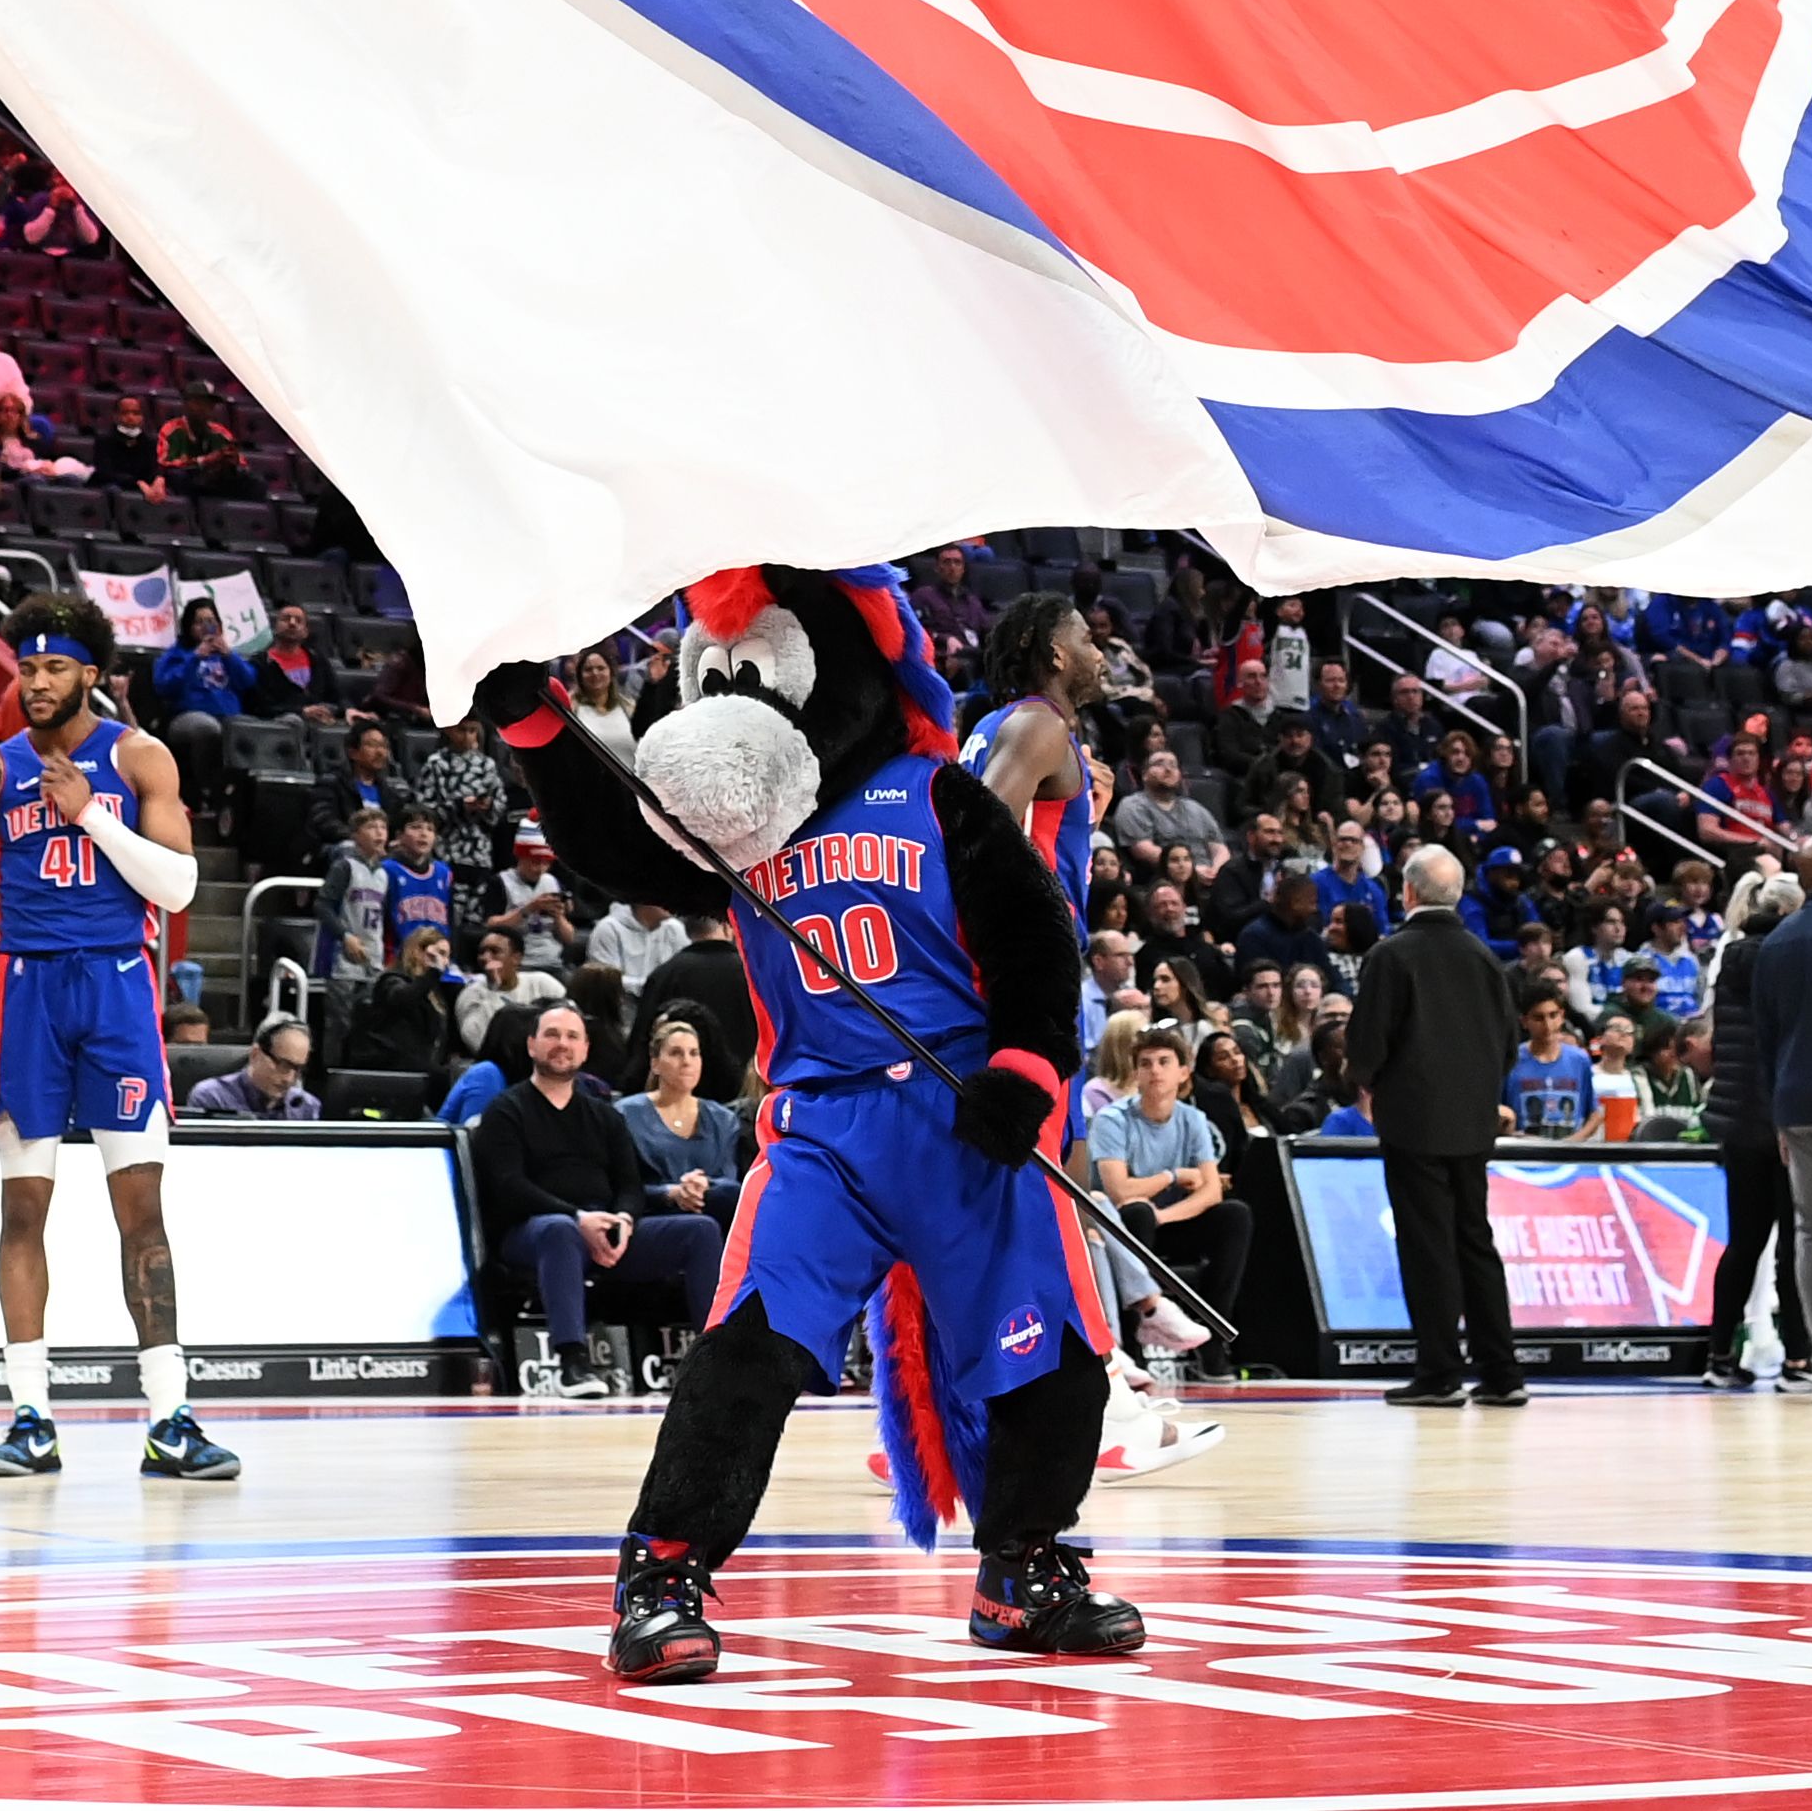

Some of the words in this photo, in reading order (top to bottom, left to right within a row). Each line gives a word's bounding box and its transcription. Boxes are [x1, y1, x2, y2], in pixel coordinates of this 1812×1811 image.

[864, 788, 907, 801] UWM
[40, 835, 96, 888] 41
[744, 832, 926, 917] DETROIT
[790, 903, 899, 995] 00
[1489, 1214, 1537, 1258] WE
[1533, 1214, 1626, 1257] HUSTLE
[1504, 1262, 1632, 1306] DIFFERENT
[308, 1357, 358, 1380] Little
[358, 1356, 428, 1379] Caesars
[1582, 1341, 1618, 1363] Little
[1618, 1340, 1671, 1362] Caesars
[46, 1360, 113, 1384] aesars
[189, 1358, 263, 1381] Caesars
